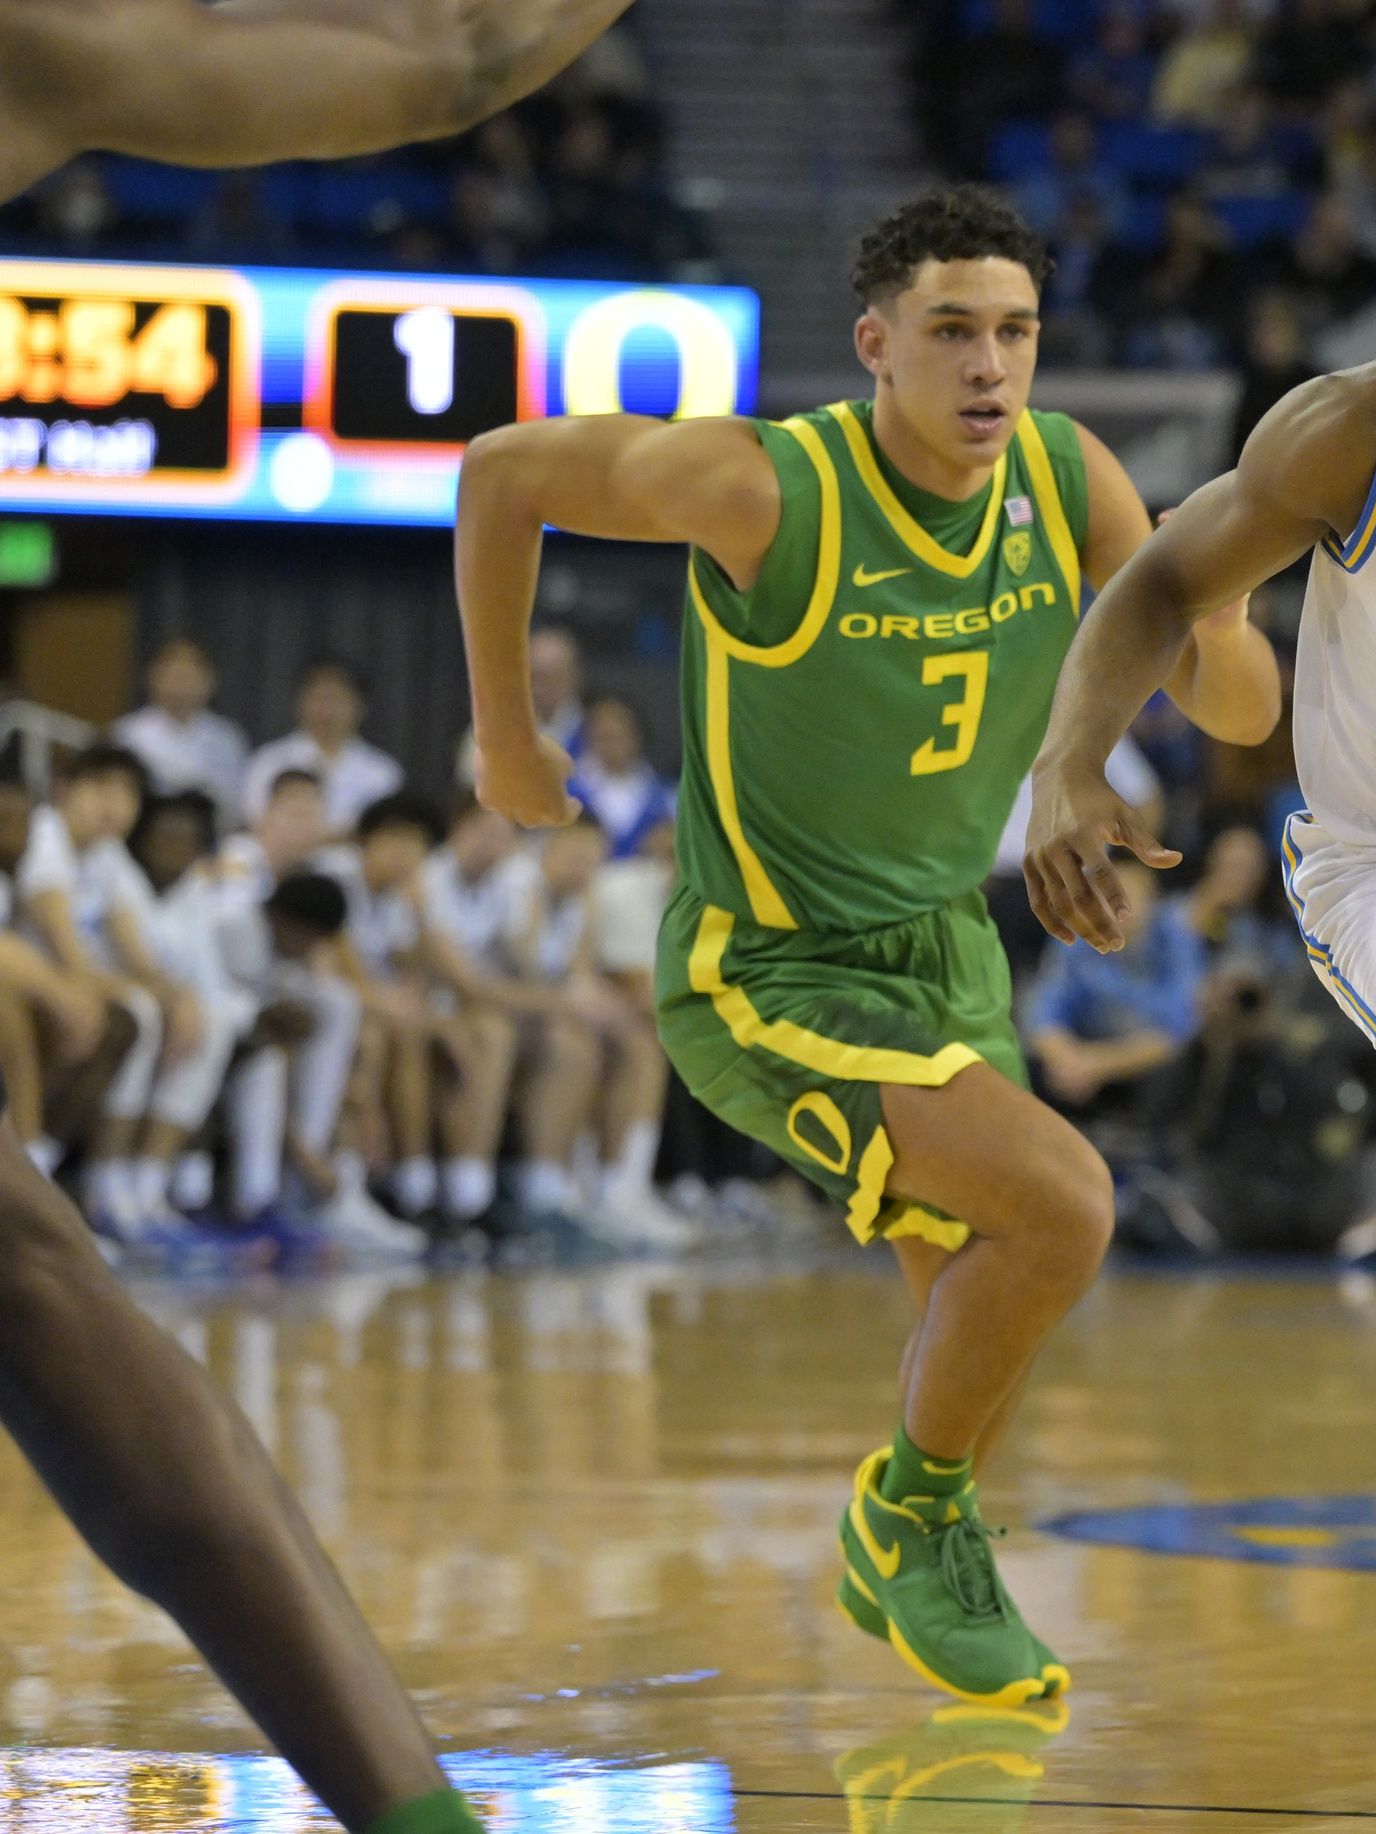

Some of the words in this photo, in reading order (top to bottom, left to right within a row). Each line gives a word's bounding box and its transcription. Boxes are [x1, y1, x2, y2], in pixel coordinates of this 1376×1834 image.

[394, 307, 453, 414] 1
[838, 582, 1056, 640] OREGON
[910, 651, 989, 776] 3
